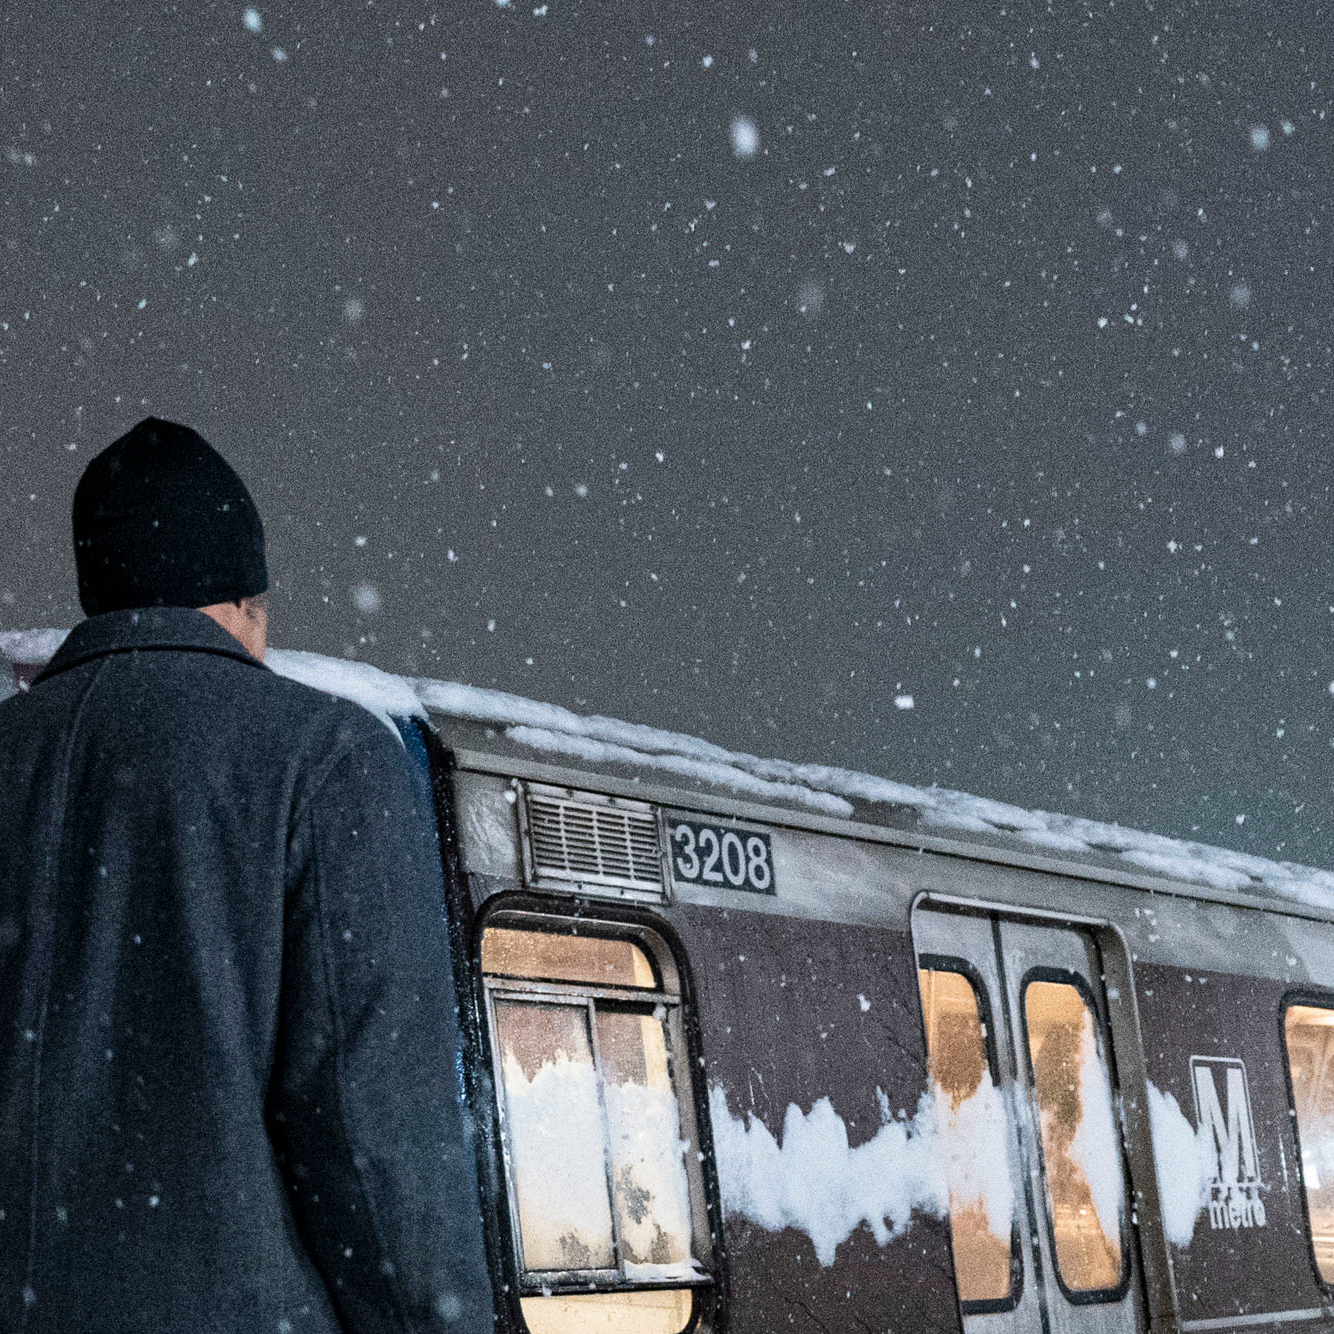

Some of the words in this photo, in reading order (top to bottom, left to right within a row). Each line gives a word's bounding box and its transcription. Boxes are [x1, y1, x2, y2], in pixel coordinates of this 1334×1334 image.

[675, 824, 771, 889] 3208
[1194, 1066, 1256, 1183] M
[1208, 1194, 1267, 1229] metro
